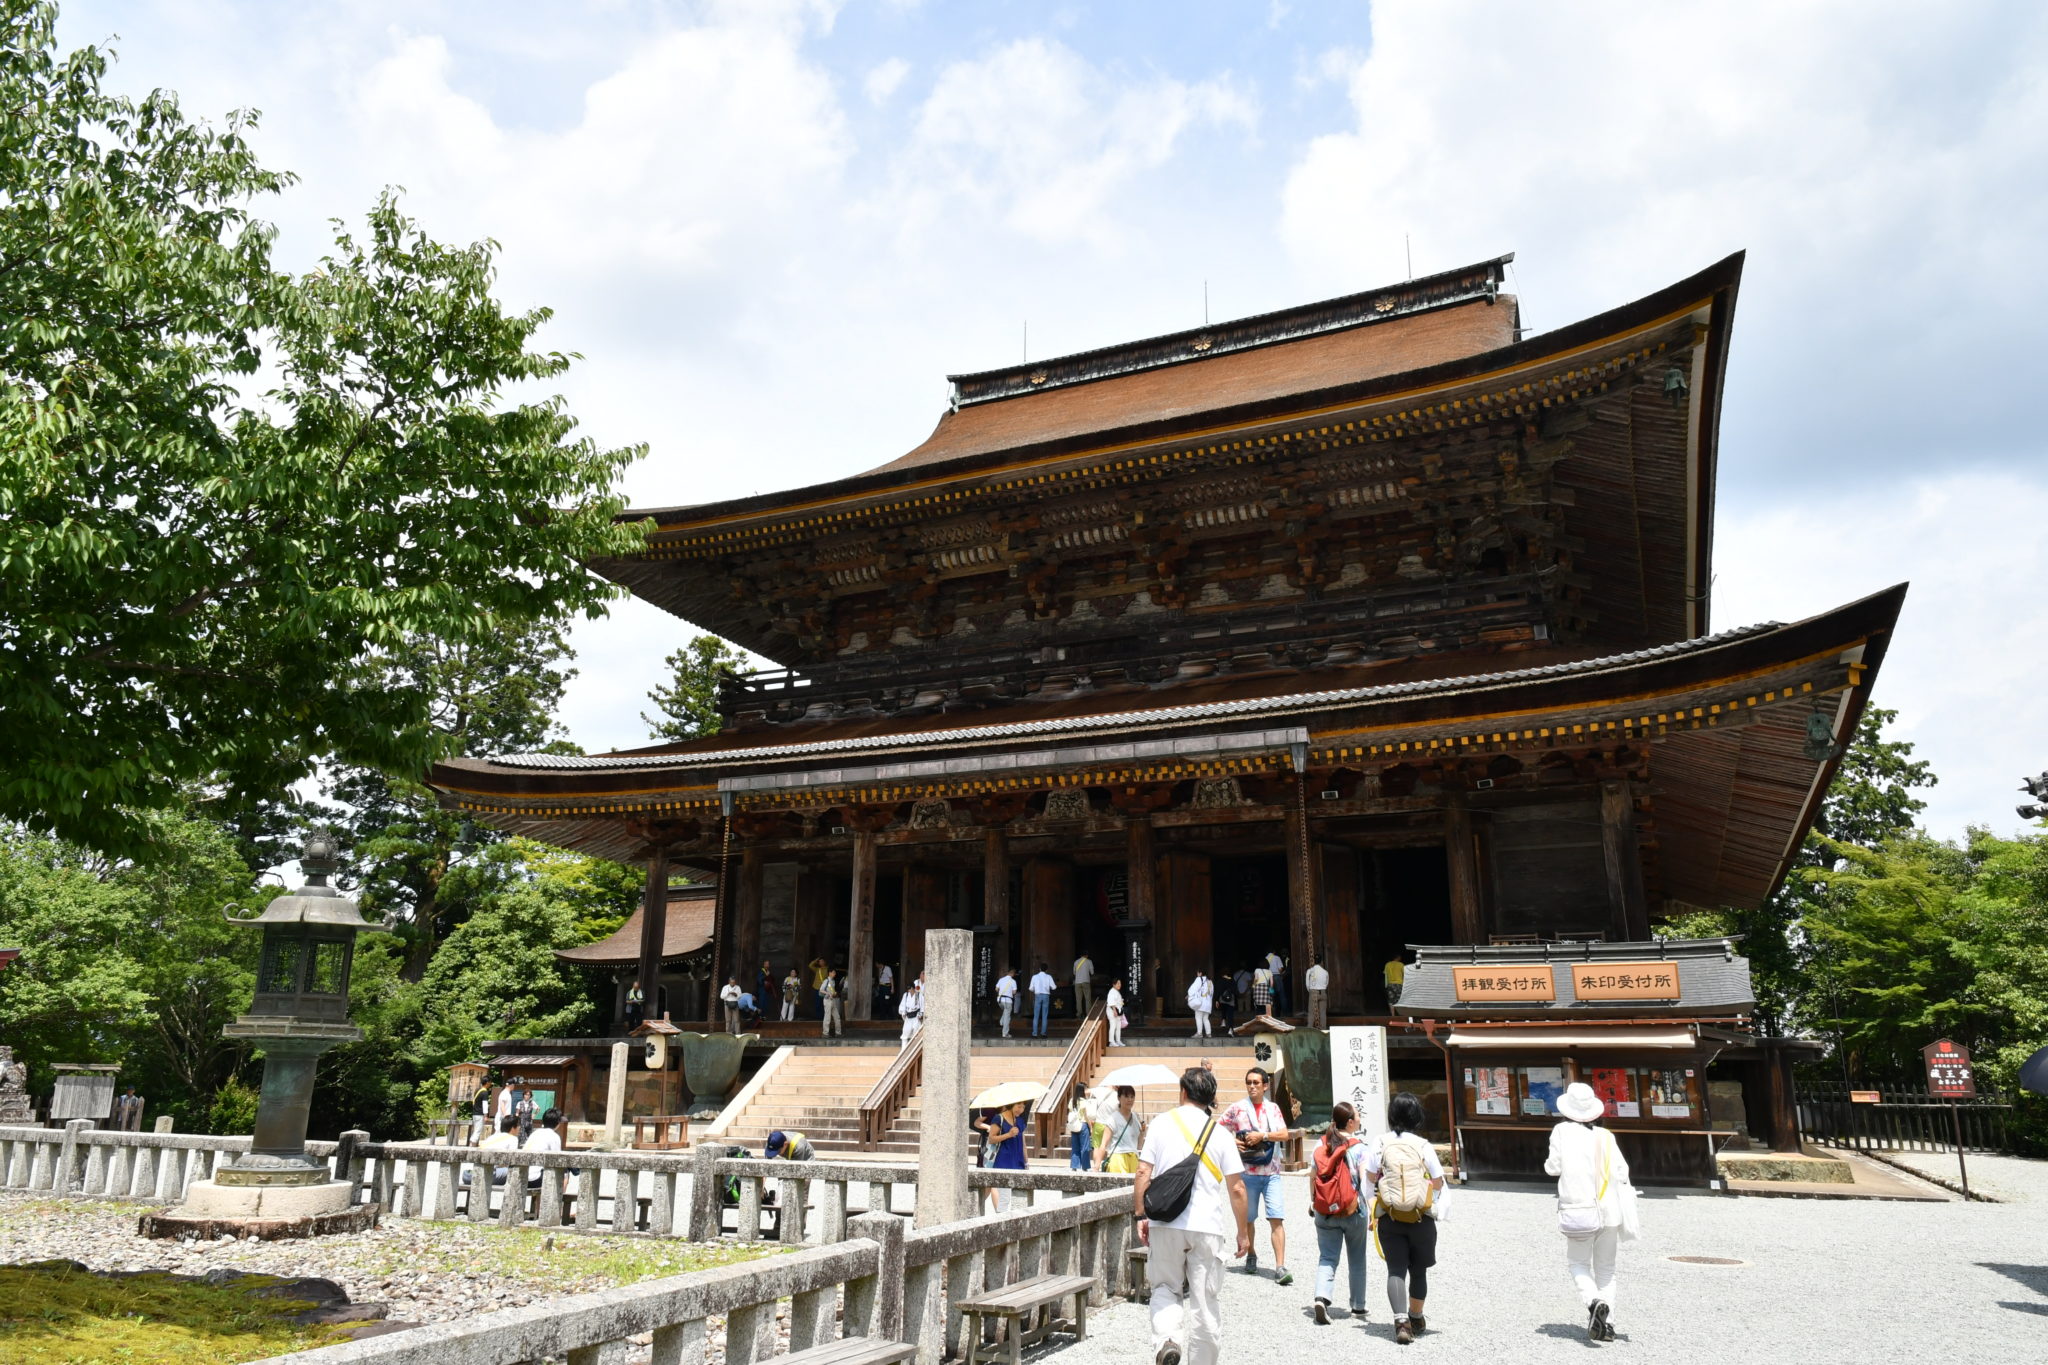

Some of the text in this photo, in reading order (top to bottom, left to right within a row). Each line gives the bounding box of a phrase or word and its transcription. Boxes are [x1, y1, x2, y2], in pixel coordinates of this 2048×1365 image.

[1461, 977, 1547, 991] 拝観受付所
[1581, 974, 1671, 989] 朱印受付所
[1350, 1086, 1368, 1146] 金峯山
